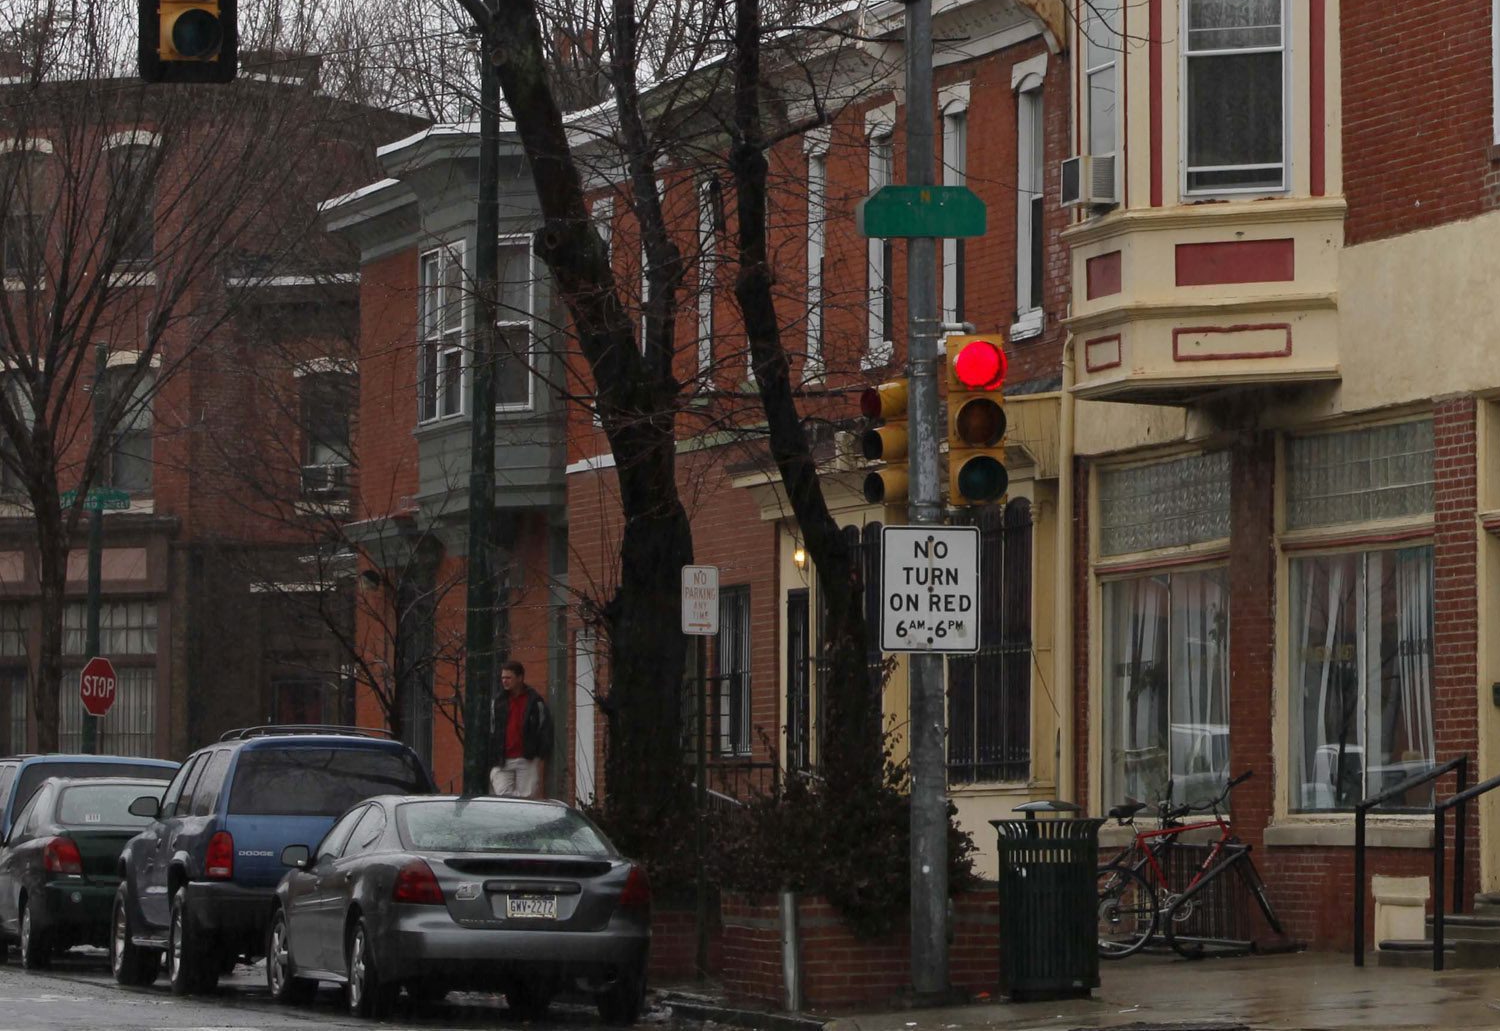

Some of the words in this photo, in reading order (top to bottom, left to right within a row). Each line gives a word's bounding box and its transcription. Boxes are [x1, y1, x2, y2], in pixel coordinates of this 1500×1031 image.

[914, 540, 948, 559] NO
[693, 572, 707, 585] NO
[903, 566, 959, 585] TURN
[684, 587, 716, 601] PARKING
[889, 593, 919, 611] ON
[929, 594, 972, 612] RED
[83, 675, 115, 699] STOP
